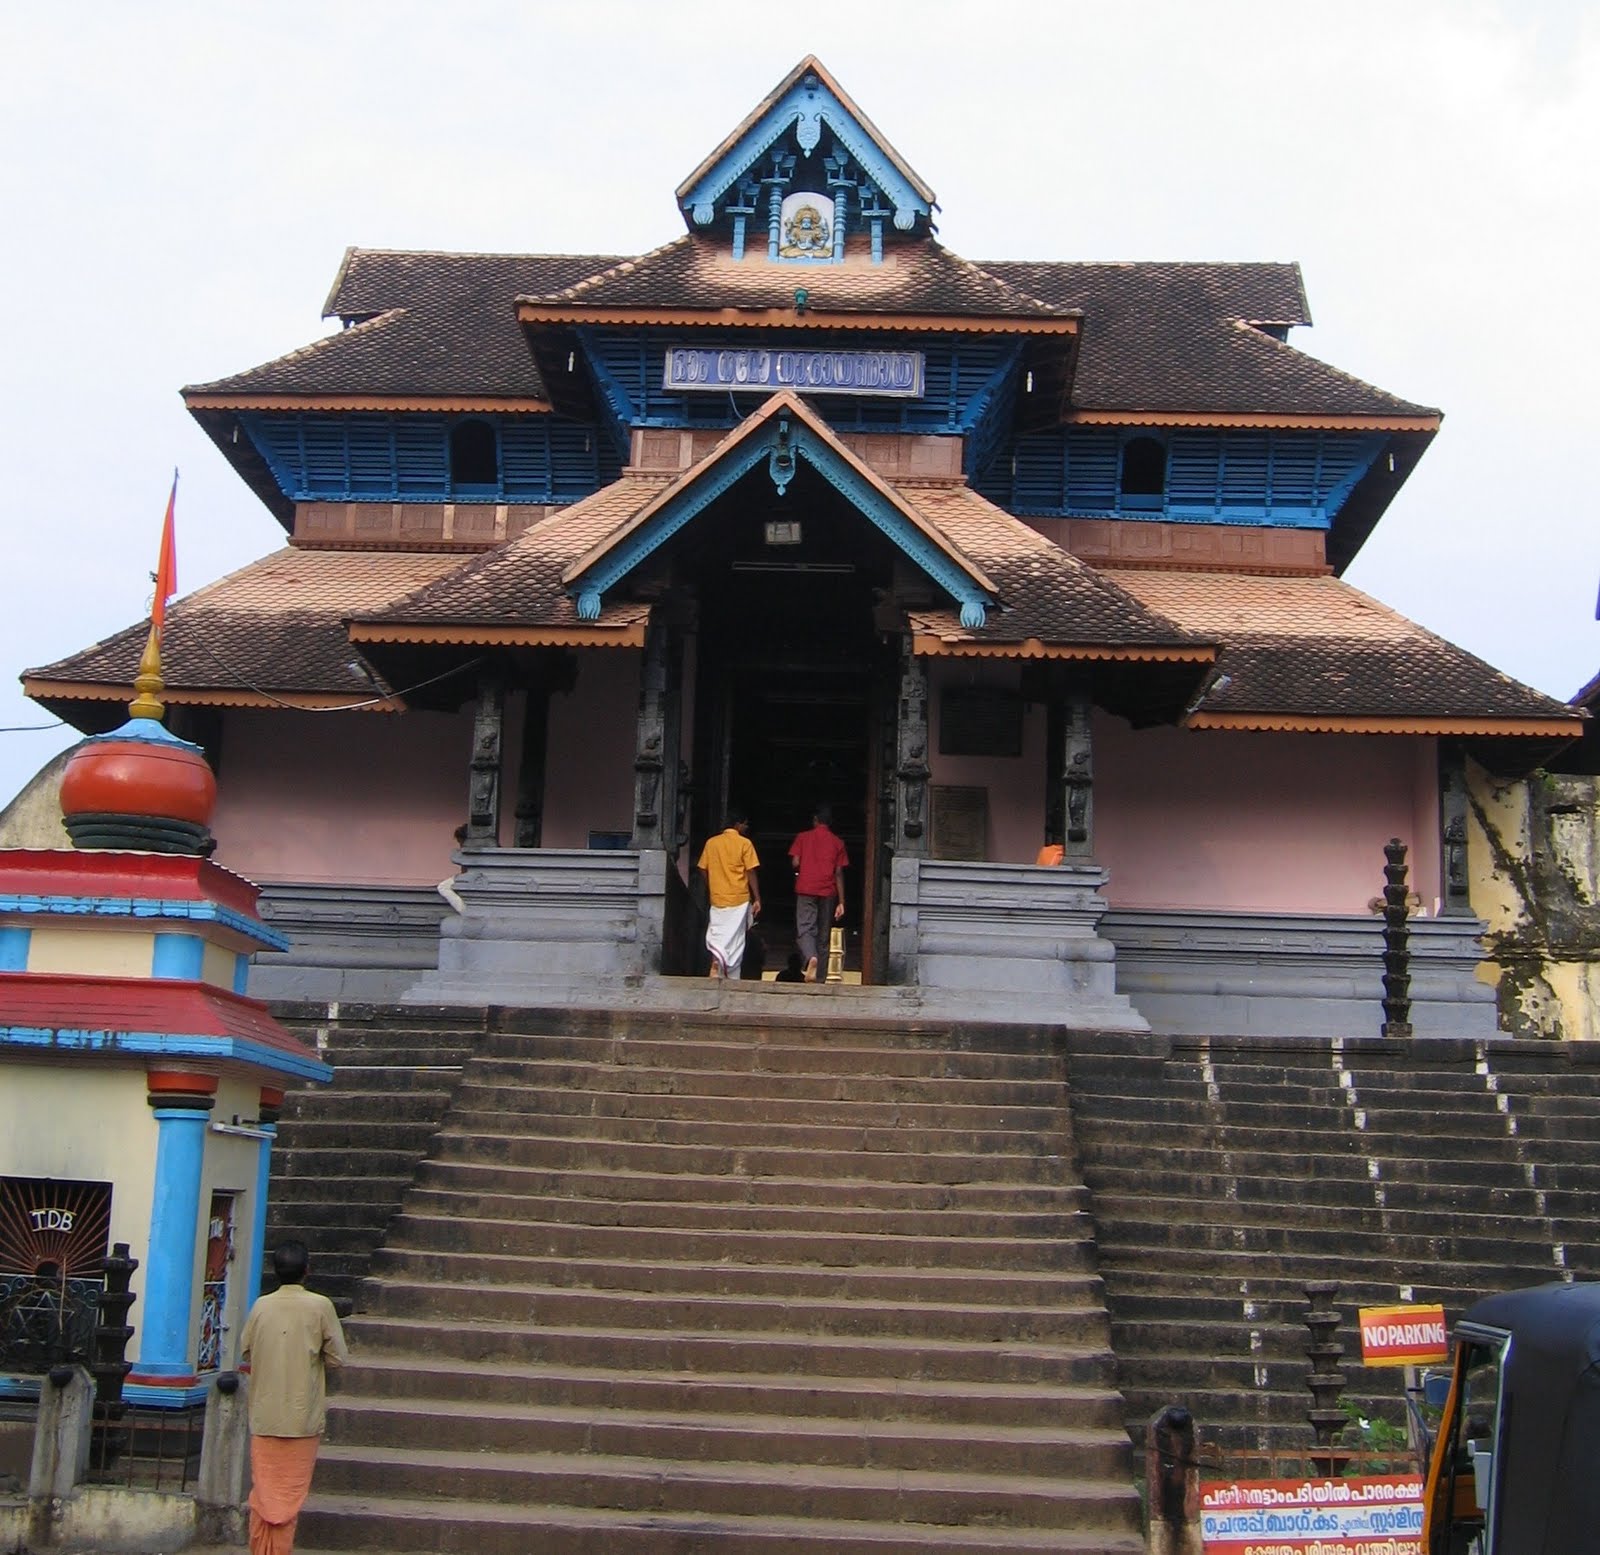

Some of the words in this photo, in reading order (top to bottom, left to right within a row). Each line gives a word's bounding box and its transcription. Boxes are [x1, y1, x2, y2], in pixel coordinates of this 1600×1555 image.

[30, 1210, 74, 1231] TDB
[1363, 1326, 1388, 1348] NO
[1388, 1323, 1446, 1346] PARKING
[1351, 1483, 1423, 1501] പാദരക്ഷ
